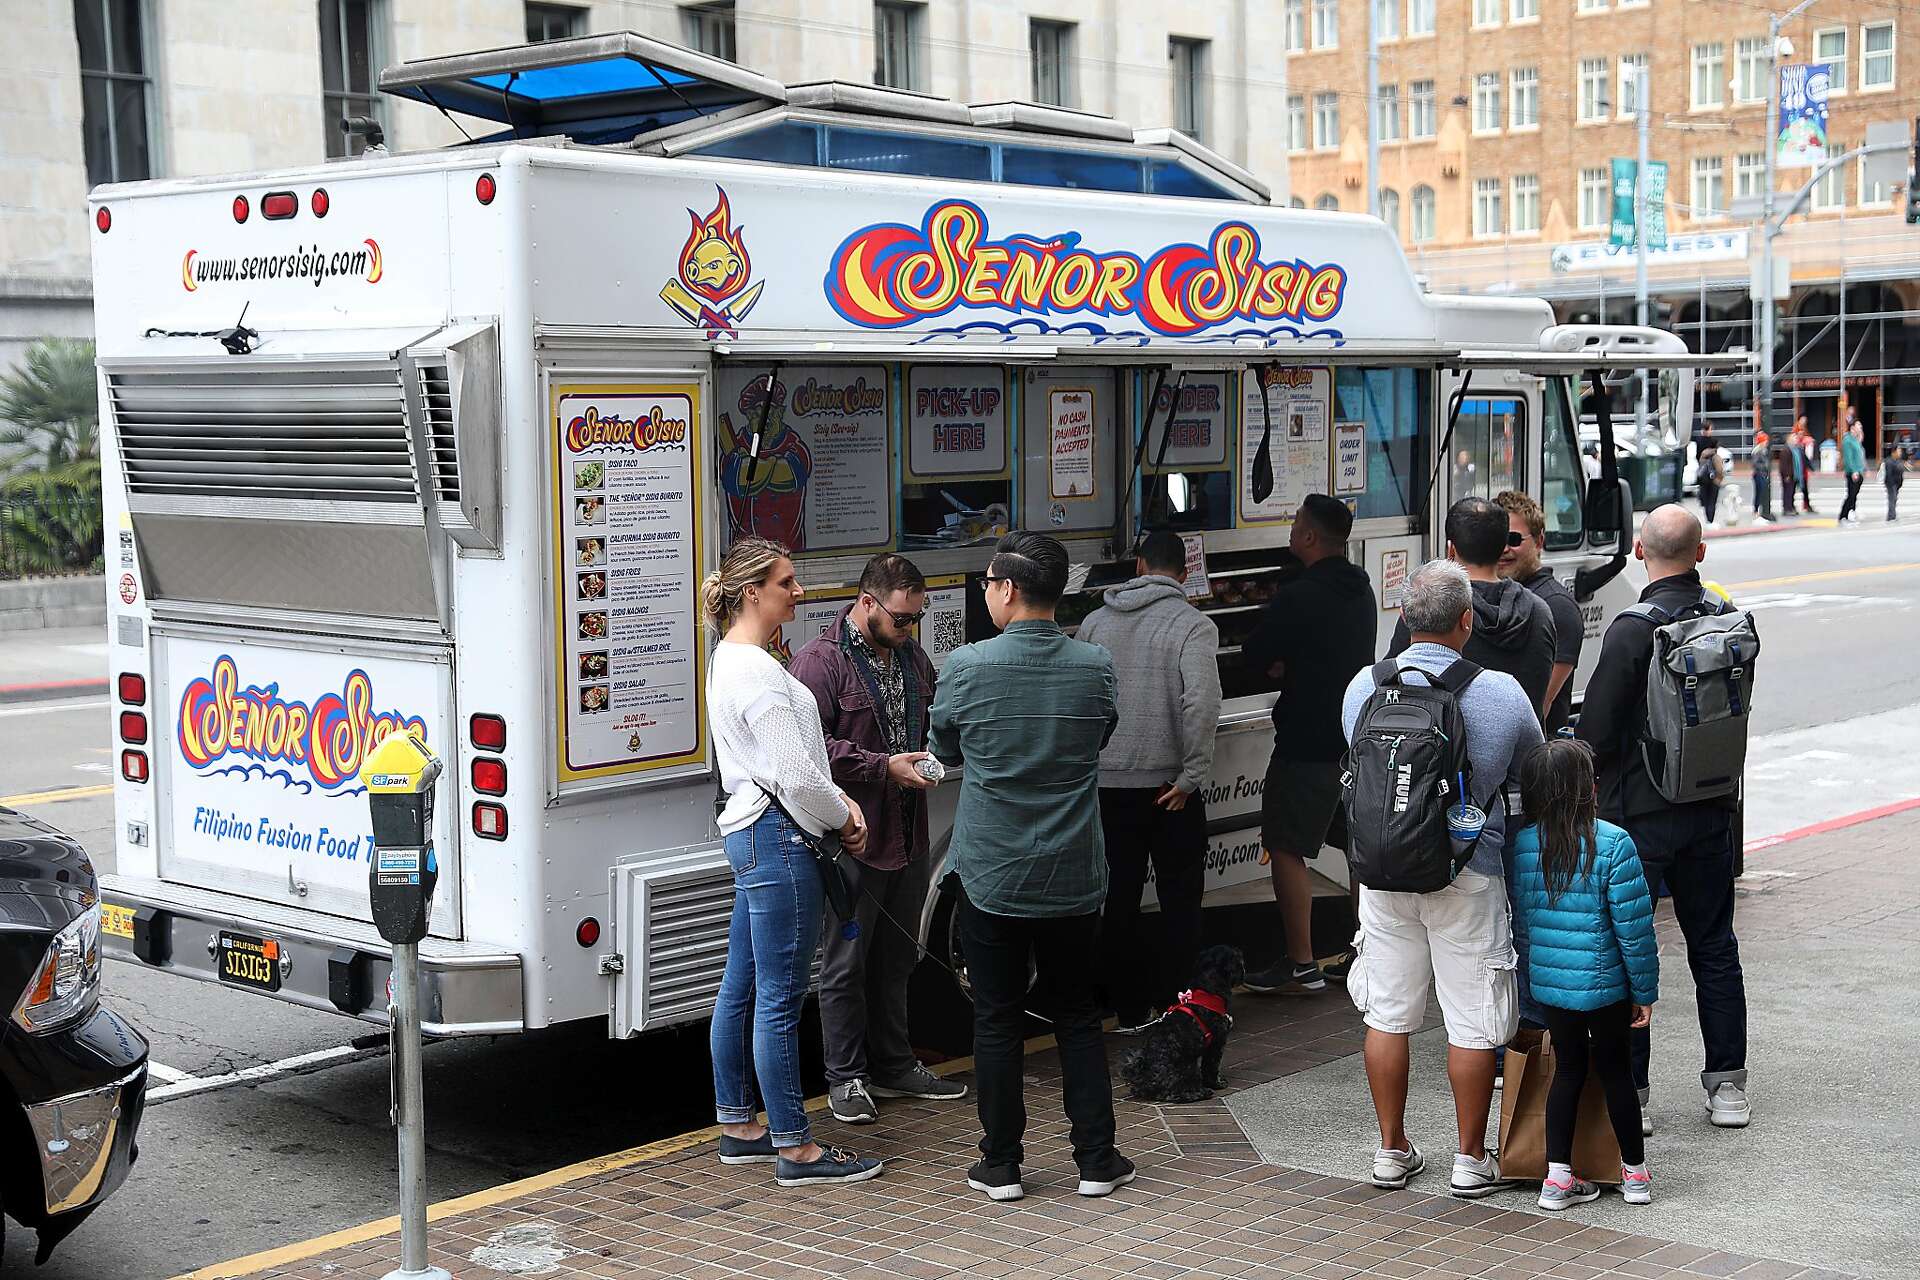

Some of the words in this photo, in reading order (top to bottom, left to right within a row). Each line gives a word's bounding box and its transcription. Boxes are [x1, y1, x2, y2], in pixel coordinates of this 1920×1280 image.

[196, 245, 367, 287] www.senorsisig.com
[824, 199, 1143, 328] SEÑOR
[1144, 221, 1347, 336] SISIG
[916, 387, 1000, 417] PICK-UP
[1058, 413, 1068, 426] NO
[1069, 410, 1087, 423] CASH
[633, 405, 686, 451] SISIG
[1055, 424, 1090, 440] PAYMENTS
[933, 423, 985, 453] HERE
[1339, 439, 1360, 449] ORDER
[1056, 438, 1089, 455] ACCEPTED
[623, 459, 638, 467] TACO
[1341, 453, 1359, 463] LIMIT
[645, 493, 659, 501] SISIG
[660, 492, 683, 500] BURRITO
[610, 534, 642, 542] CALIFORNIA
[657, 531, 680, 539] BURRITO
[610, 569, 625, 577] SISIG
[626, 568, 641, 576] FRIES
[611, 608, 626, 616] SISIG
[626, 606, 649, 615] NACHOS
[612, 648, 627, 656] SISIG
[658, 643, 671, 651] RICE
[613, 681, 627, 689] SISIG
[628, 679, 646, 688] SALAD
[178, 655, 308, 769] SEÑOR
[623, 714, 638, 723] SILOG
[371, 775, 409, 786] SFpark
[1393, 763, 1412, 813] THULE
[1201, 780, 1231, 805] sion
[194, 806, 252, 842] Filipino
[257, 817, 311, 852] Fusion
[316, 827, 360, 862] Food
[226, 951, 271, 983] SISIG3
